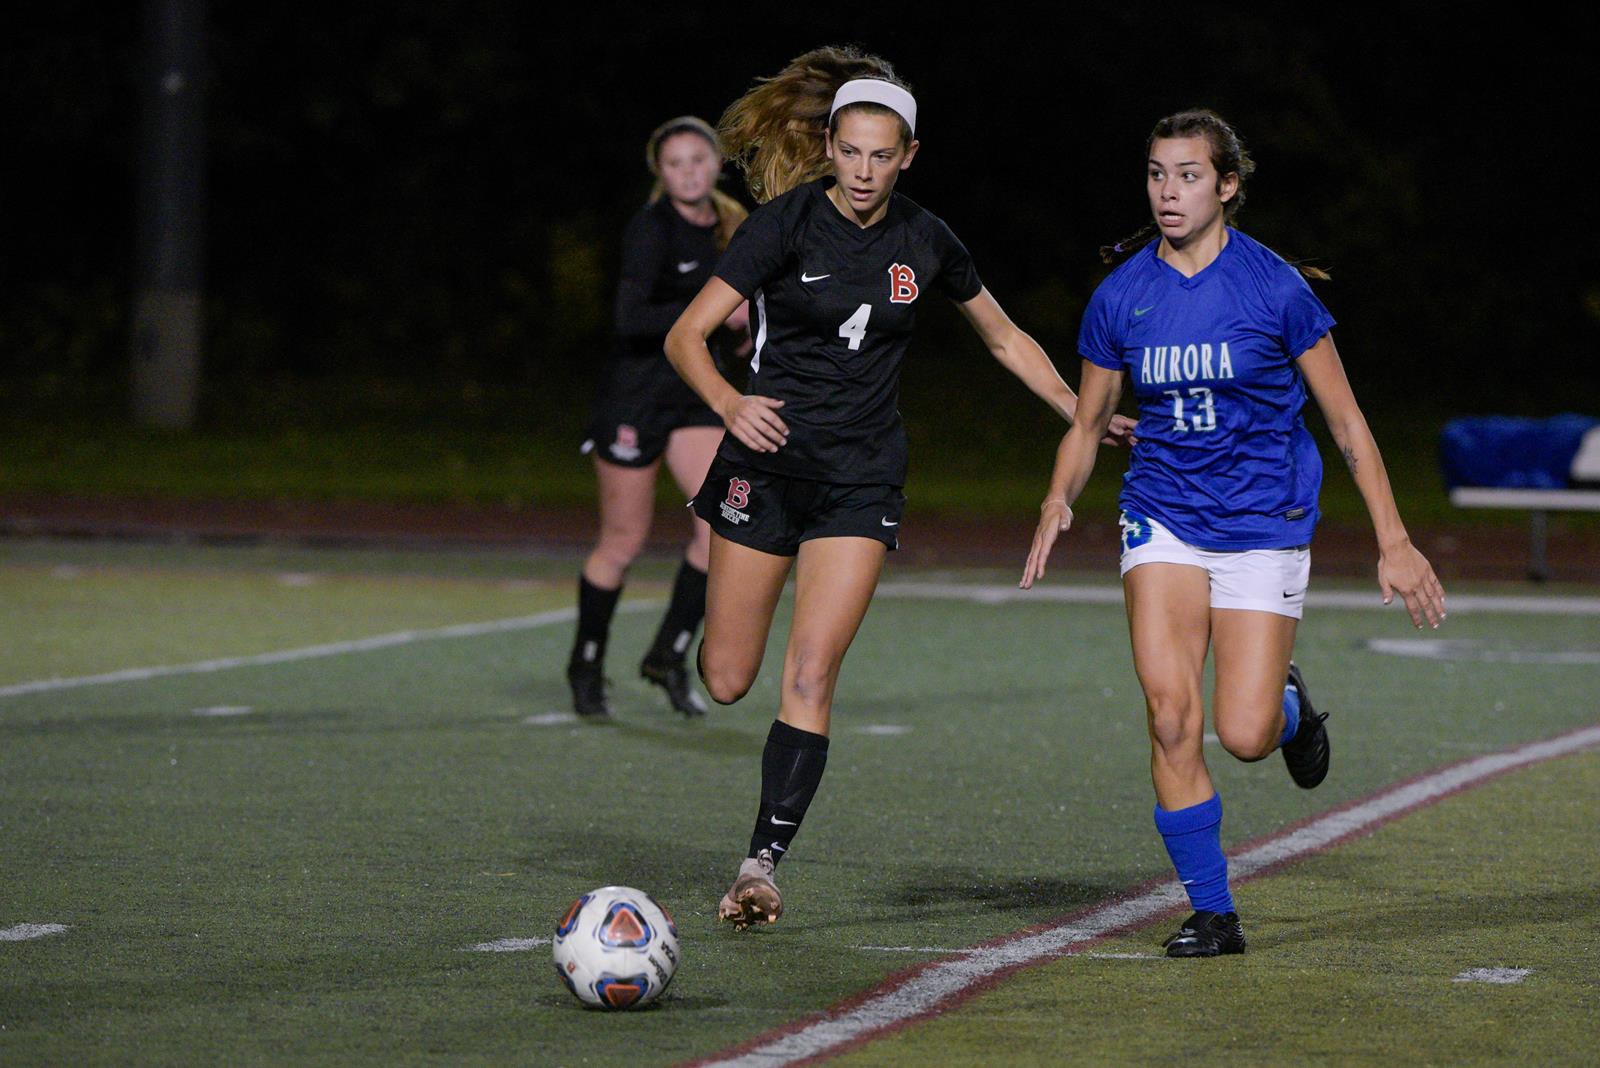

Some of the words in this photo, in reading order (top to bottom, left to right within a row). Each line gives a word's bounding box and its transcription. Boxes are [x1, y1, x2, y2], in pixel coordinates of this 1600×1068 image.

[888, 262, 919, 304] B
[838, 303, 872, 350] 4
[1141, 342, 1234, 384] AURORA
[1163, 387, 1217, 432] 13
[725, 476, 750, 509] B
